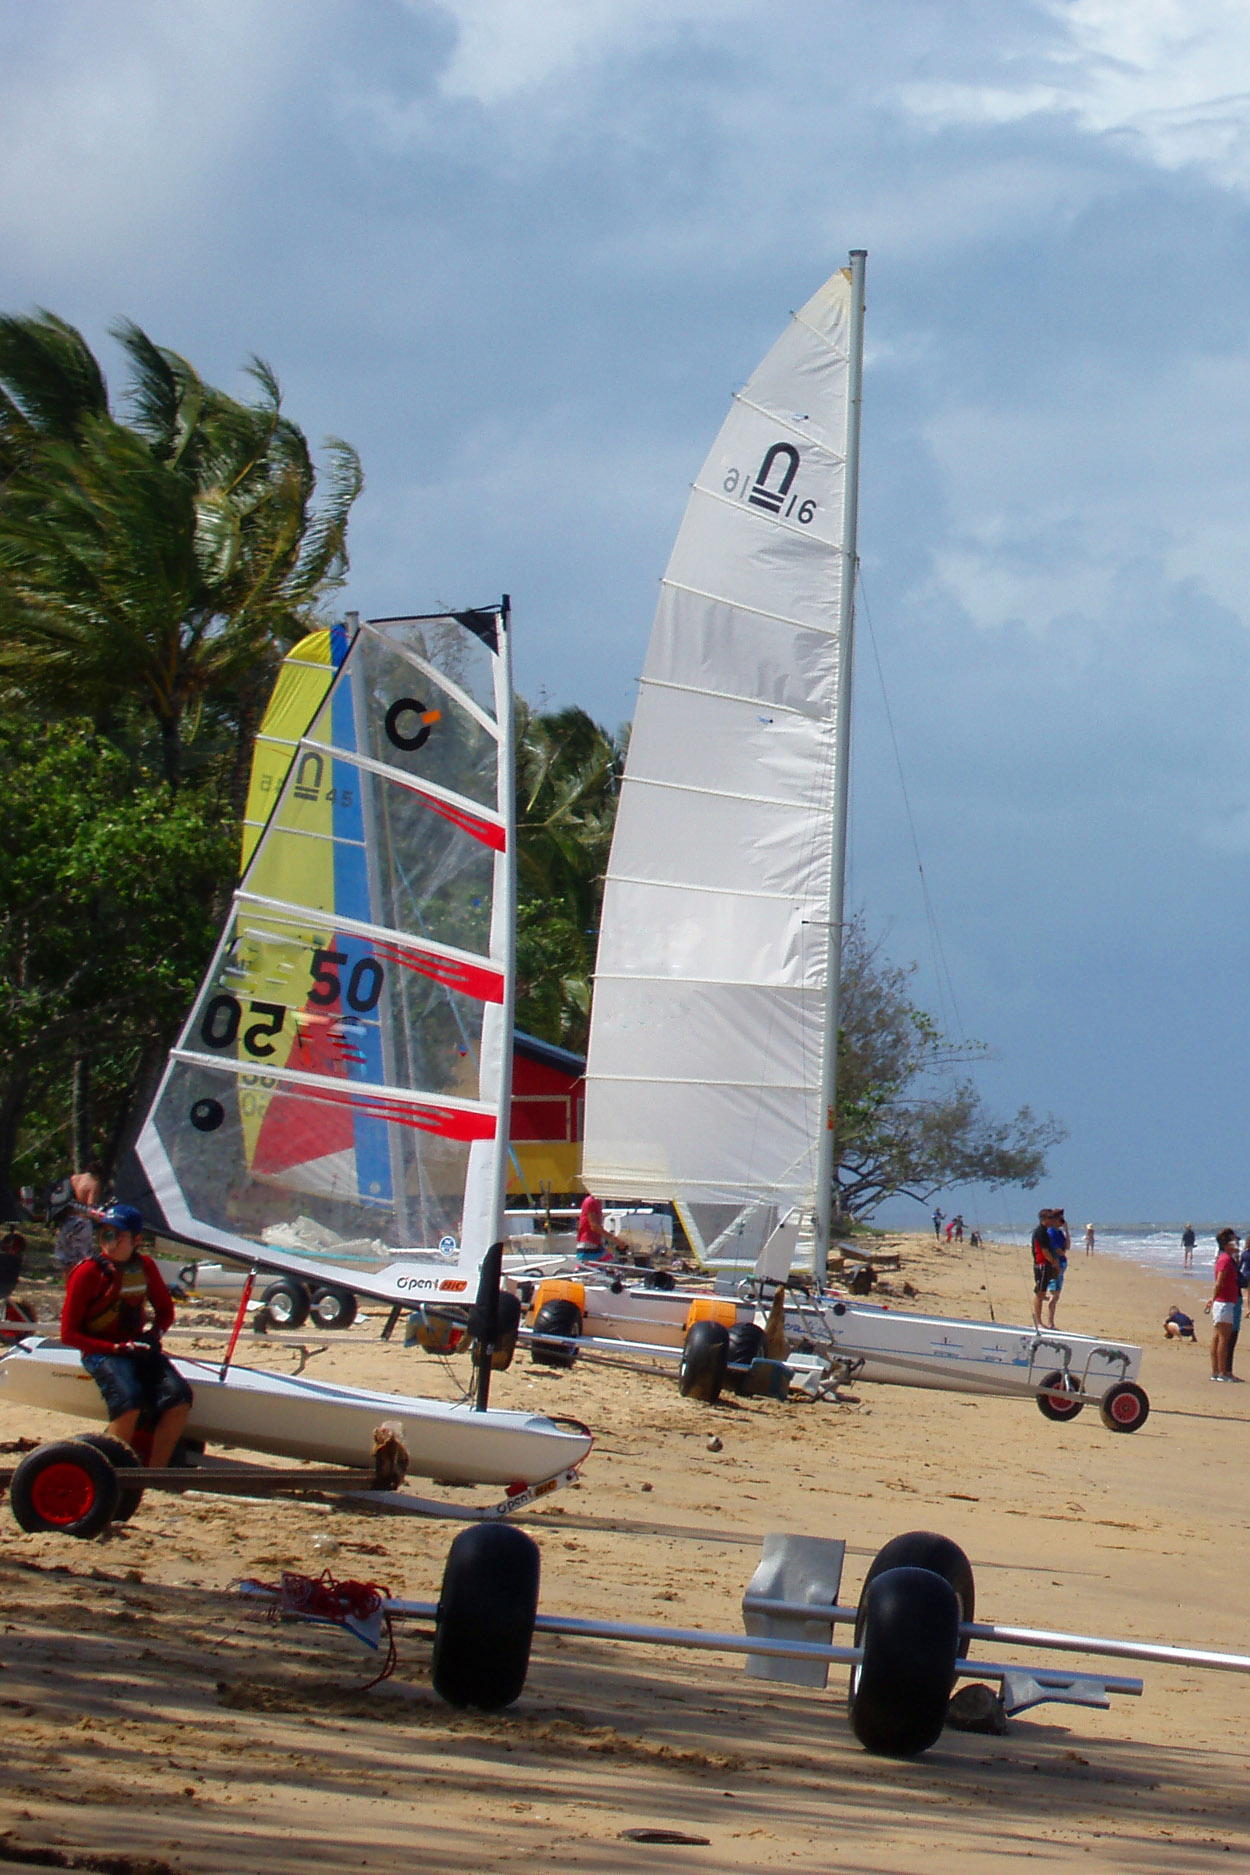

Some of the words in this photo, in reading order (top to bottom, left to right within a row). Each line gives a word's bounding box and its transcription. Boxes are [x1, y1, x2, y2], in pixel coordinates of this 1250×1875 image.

[785, 495, 817, 524] 16
[307, 950, 384, 1012] 50
[396, 1276, 432, 1290] Open
[440, 1279, 467, 1292] BIC
